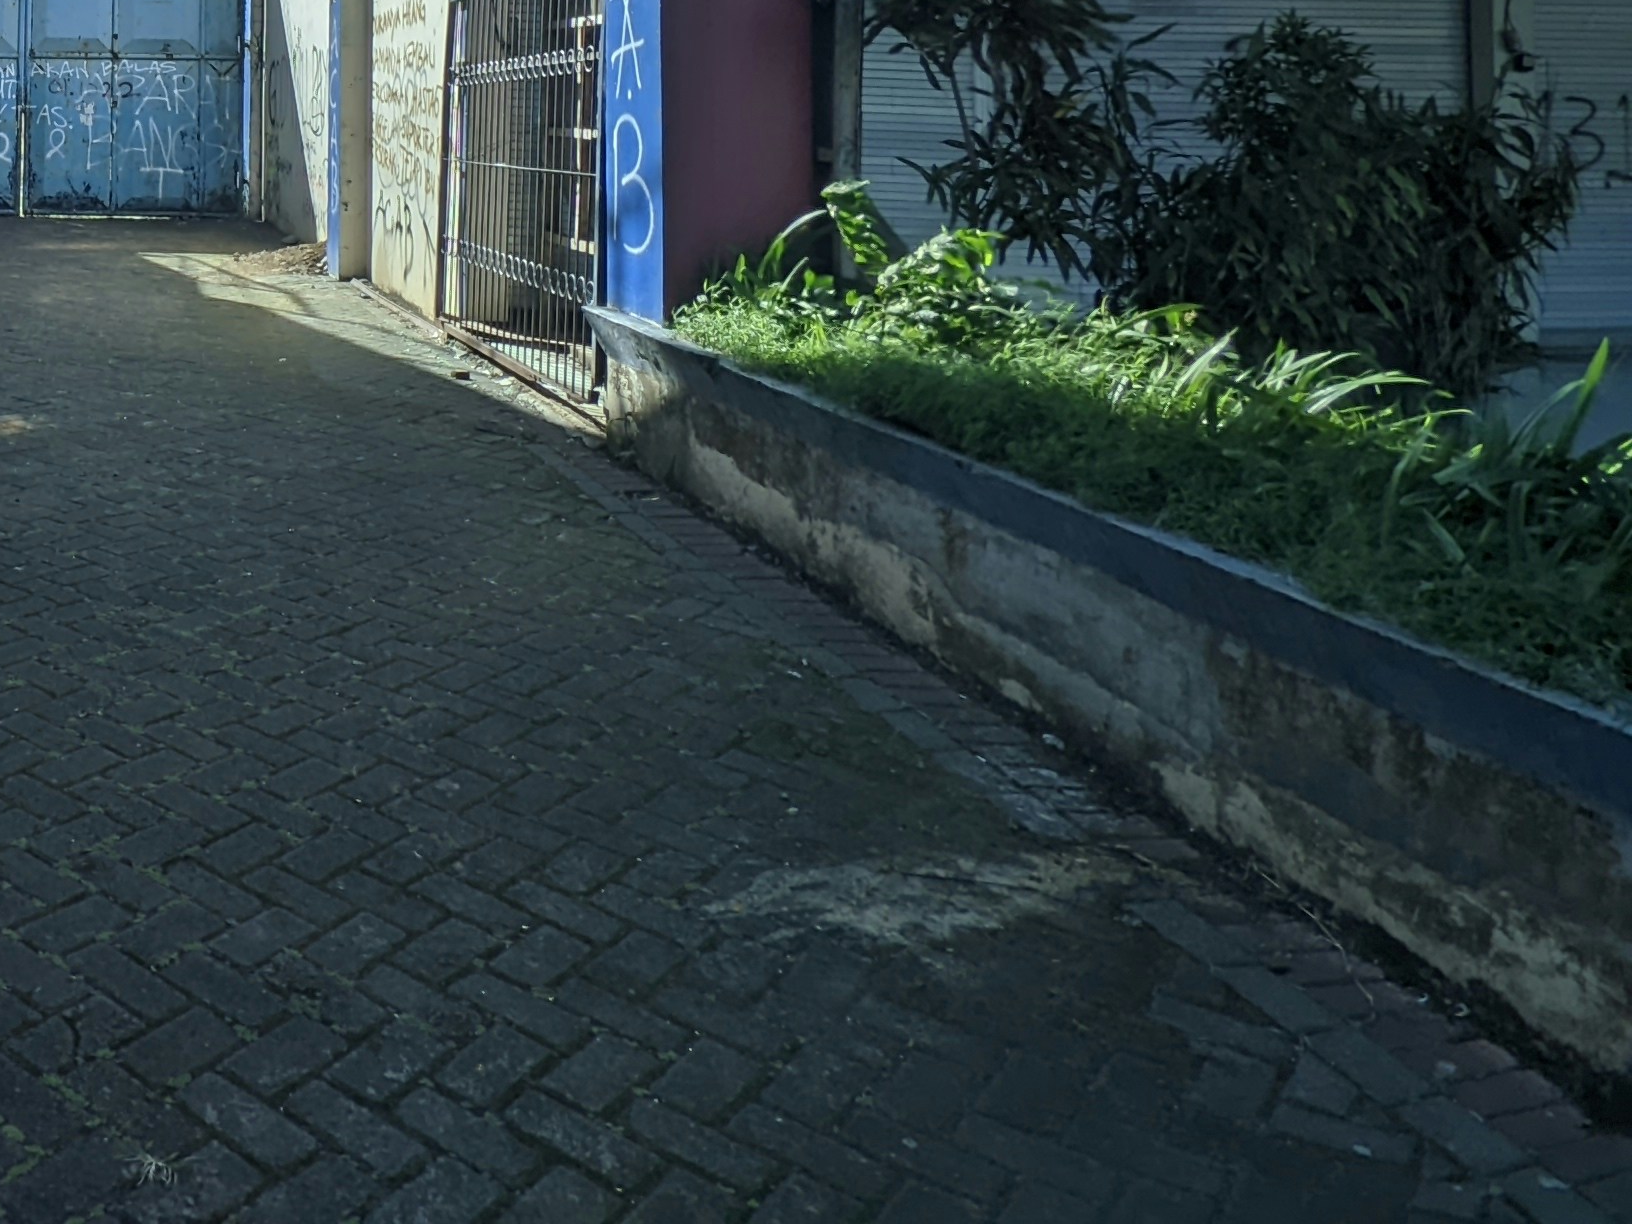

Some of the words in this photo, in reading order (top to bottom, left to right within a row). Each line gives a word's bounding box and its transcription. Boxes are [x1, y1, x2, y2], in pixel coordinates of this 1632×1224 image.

[30, 61, 89, 79] AKAN
[101, 59, 177, 75] BALAS
[74, 72, 240, 125] APARAT
